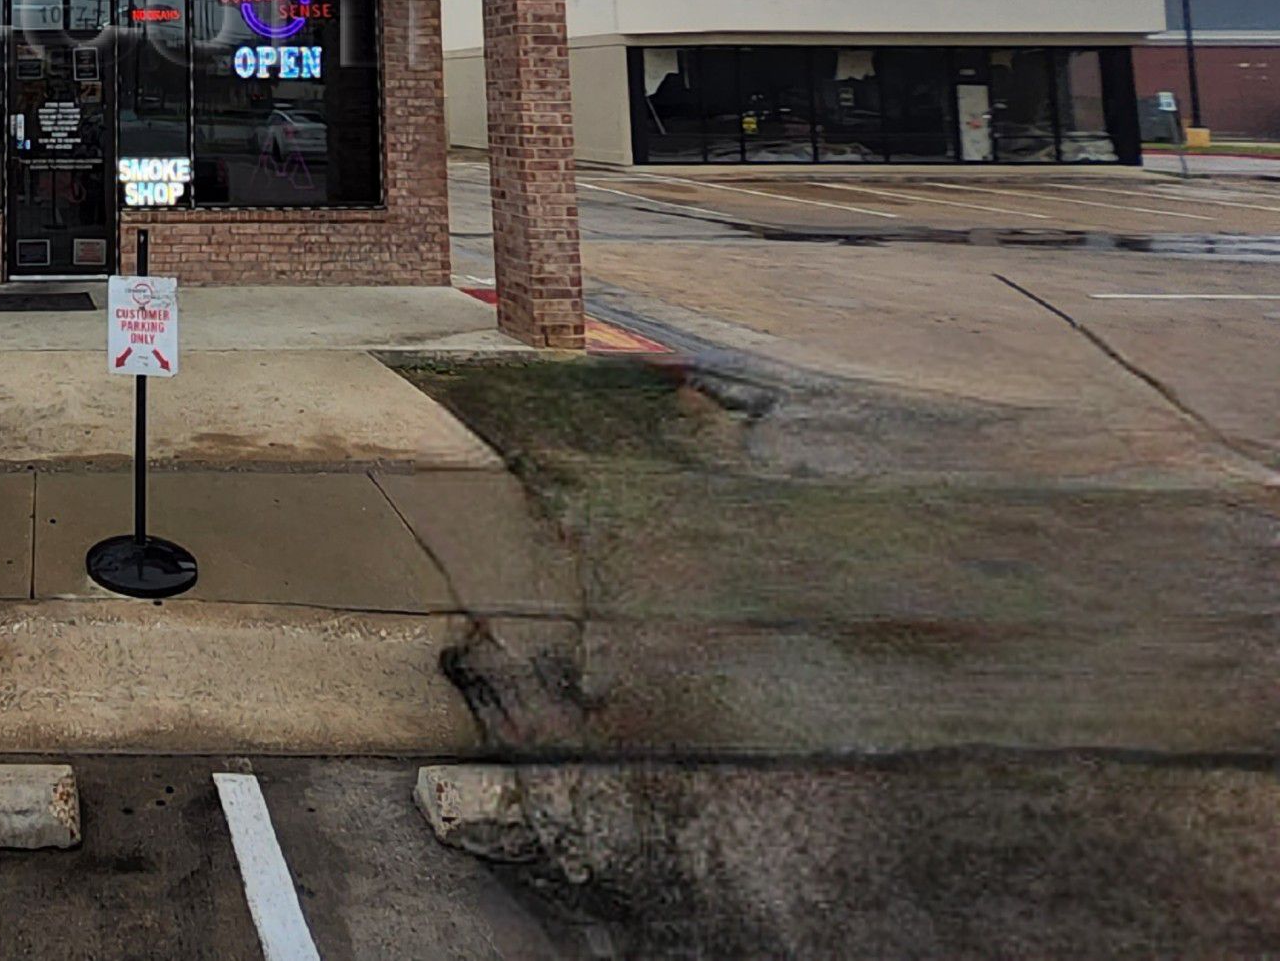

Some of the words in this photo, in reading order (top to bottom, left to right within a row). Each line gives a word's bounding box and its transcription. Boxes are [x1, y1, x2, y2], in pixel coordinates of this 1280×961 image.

[279, 3, 333, 19] SENSE
[234, 46, 322, 79] OPEN
[118, 157, 192, 182] SMOKE
[125, 181, 185, 206] SHOP
[115, 308, 171, 321] CUSTOMER
[121, 320, 166, 333] PARKING
[130, 333, 156, 344] ONLY
